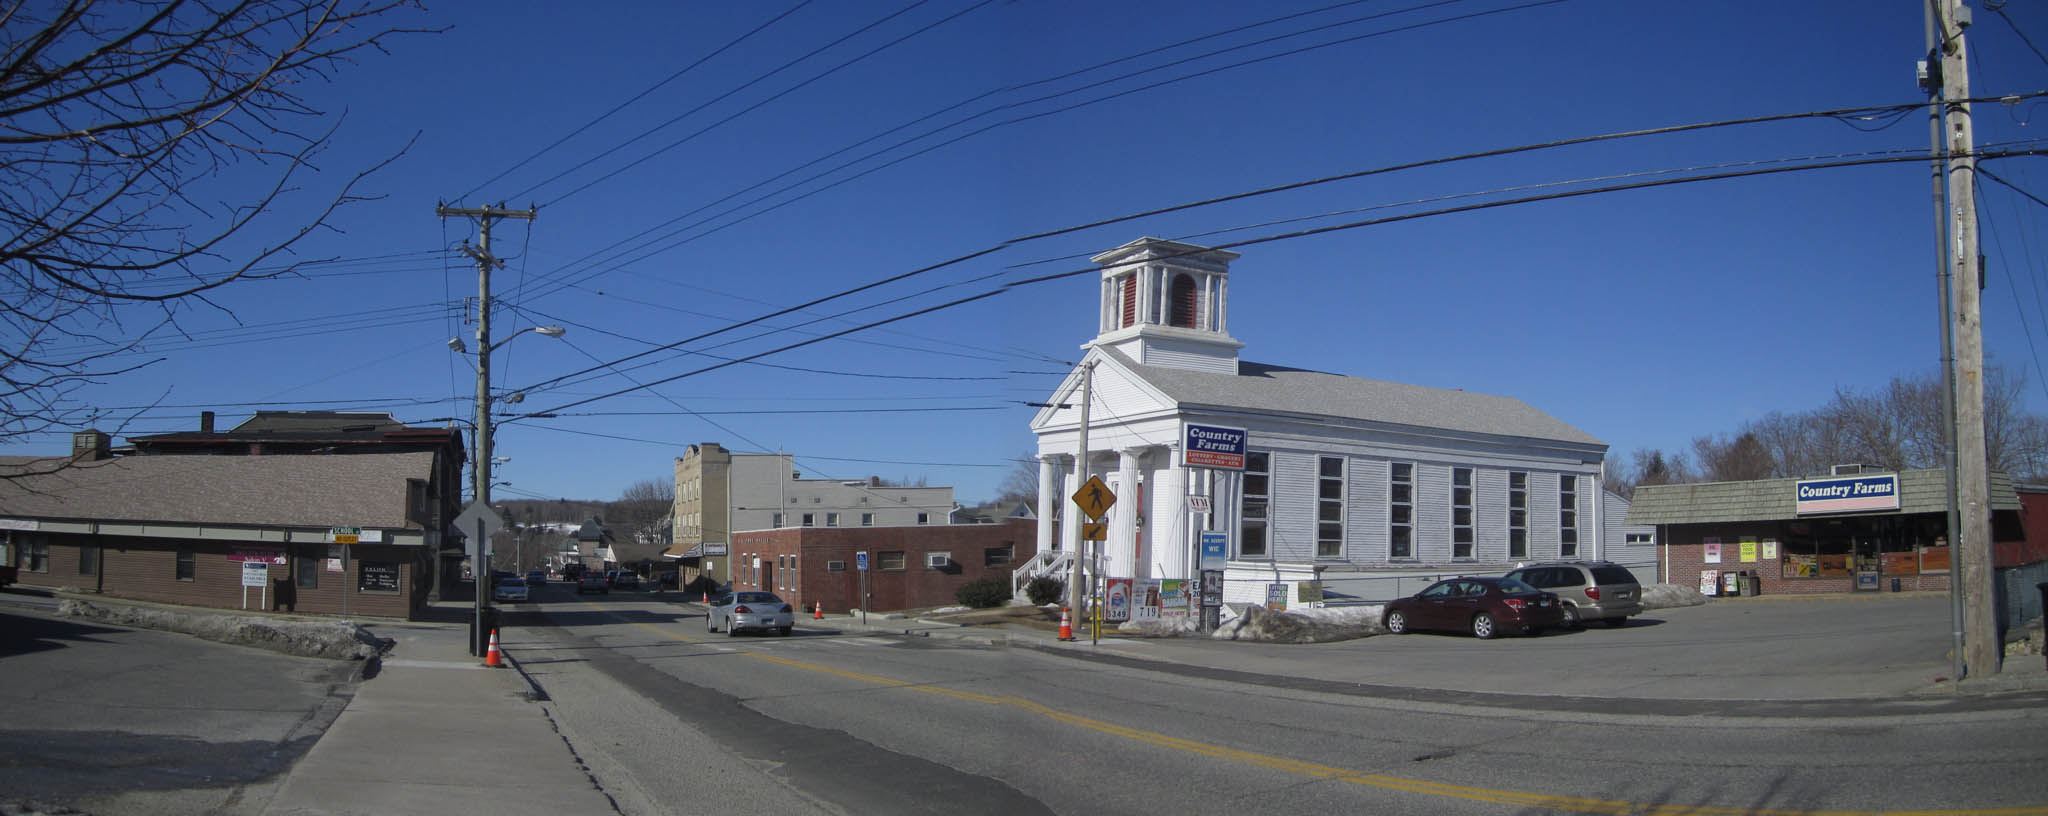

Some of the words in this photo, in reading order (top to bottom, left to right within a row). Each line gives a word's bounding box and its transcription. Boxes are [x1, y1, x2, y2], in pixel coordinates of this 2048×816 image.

[1190, 428, 1242, 443] Country
[1197, 439, 1236, 451] Farms
[1800, 485, 1851, 498] Country
[1853, 482, 1892, 495] Farms
[335, 527, 353, 535] SCHOOL
